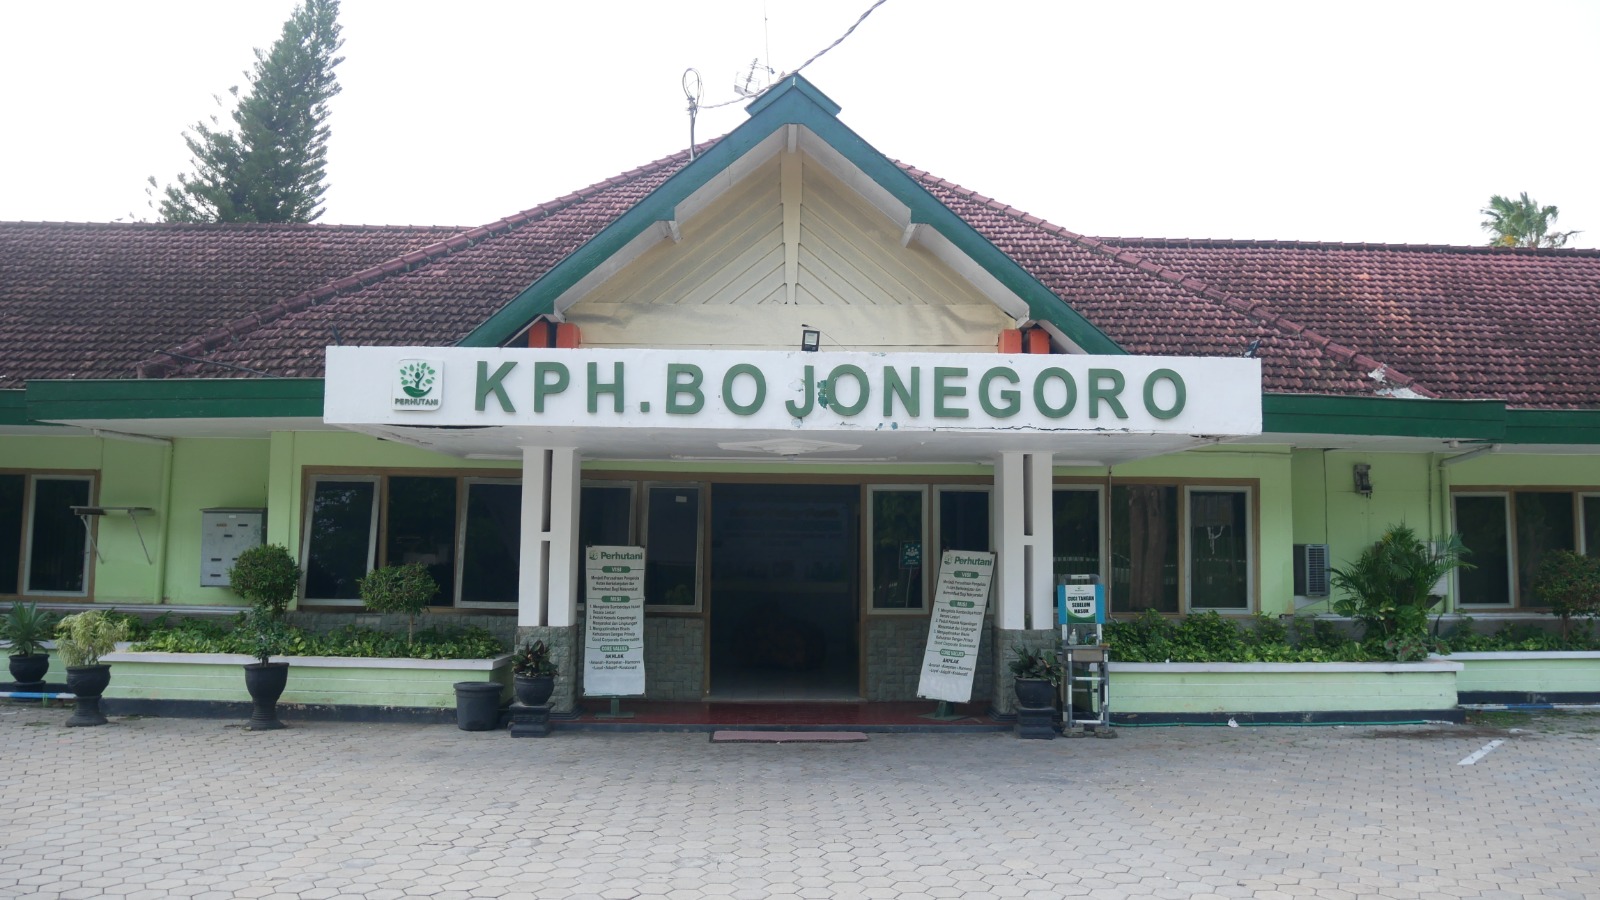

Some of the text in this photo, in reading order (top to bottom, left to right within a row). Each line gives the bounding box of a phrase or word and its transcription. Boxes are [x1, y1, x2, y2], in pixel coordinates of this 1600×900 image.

[394, 398, 439, 406] PERHUTANI
[600, 551, 643, 560] Perhutani
[954, 556, 992, 566] Perhutani
